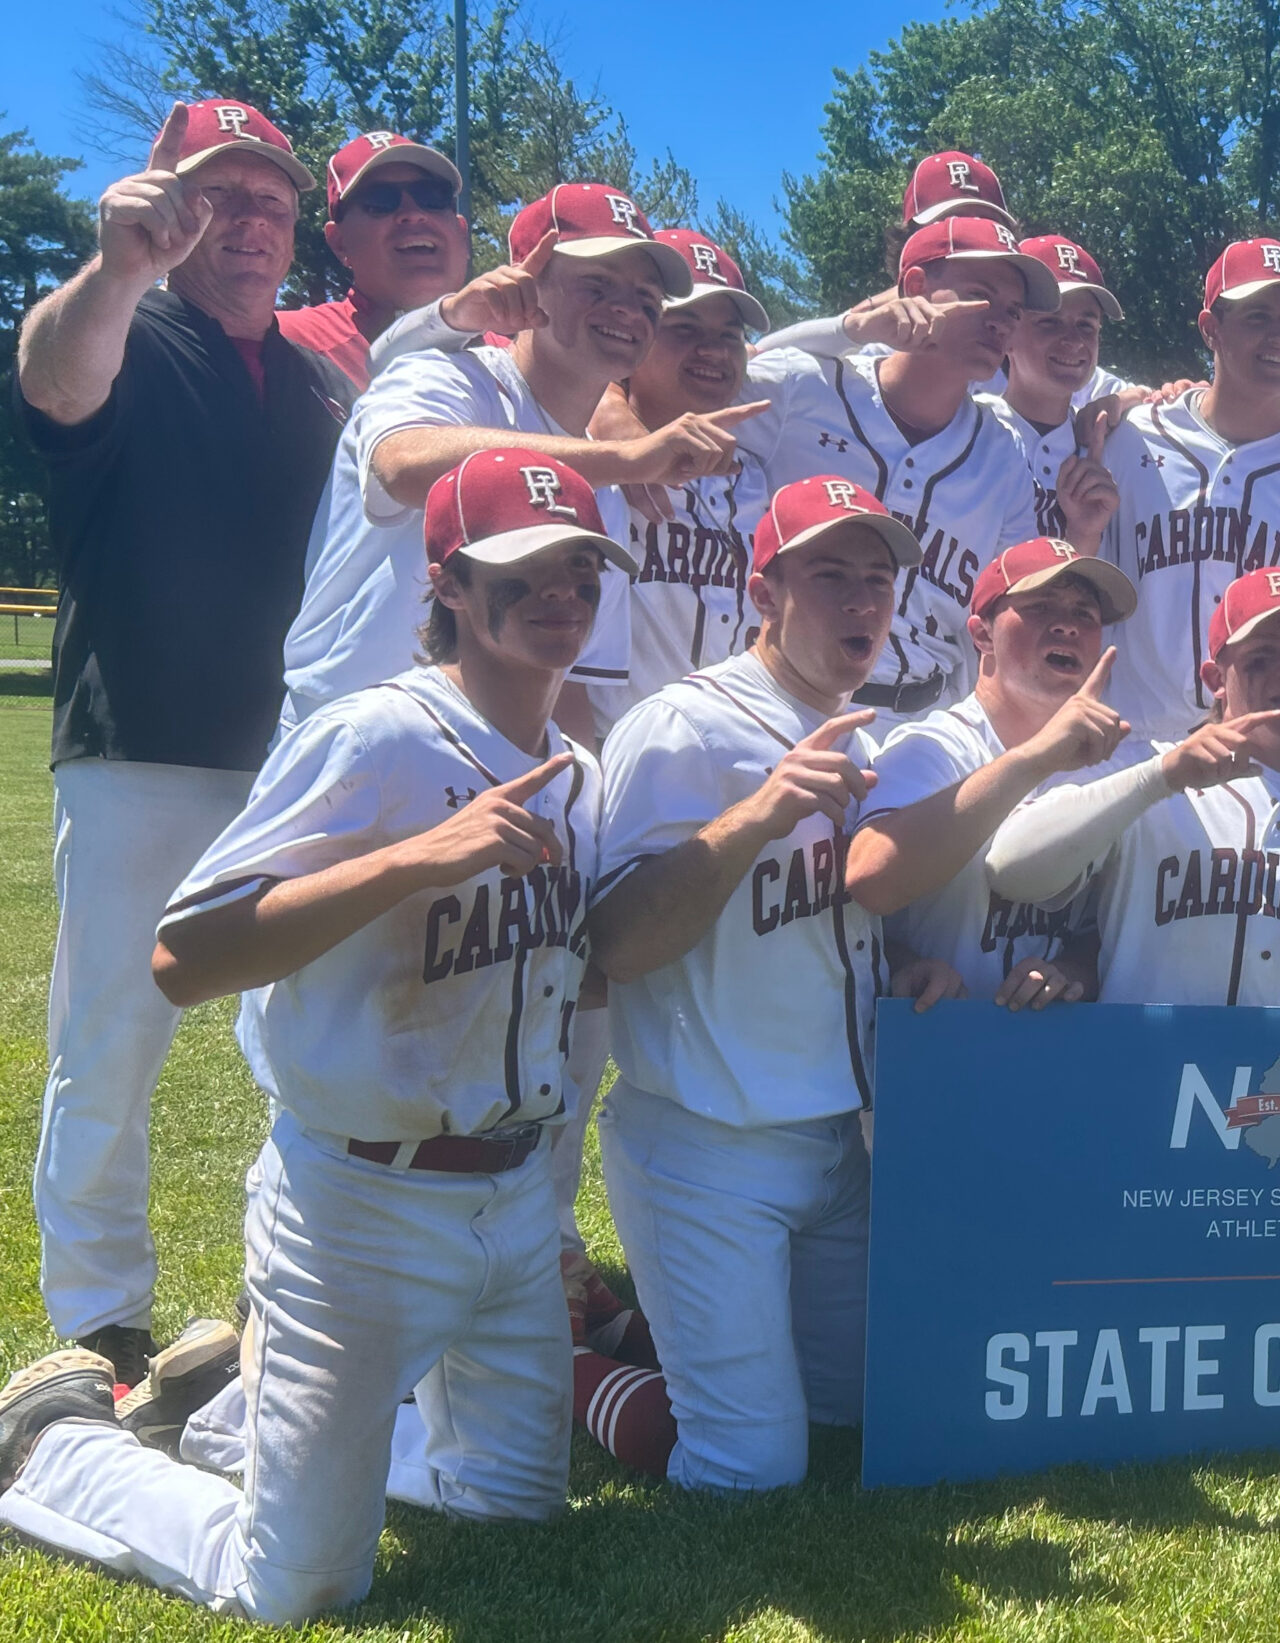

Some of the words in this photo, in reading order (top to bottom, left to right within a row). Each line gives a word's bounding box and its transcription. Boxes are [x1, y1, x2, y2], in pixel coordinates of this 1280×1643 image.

[213, 105, 262, 142] PL
[947, 161, 980, 192] PL
[605, 194, 648, 239] PL
[689, 243, 728, 285] PL
[1055, 244, 1088, 280] PL
[519, 466, 577, 518] PL
[822, 480, 870, 513] PL
[1258, 1098, 1280, 1112] Est.
[1123, 1189, 1174, 1208] NEW
[1180, 1188, 1263, 1207] JERSEY
[985, 1324, 1226, 1421] STATE
